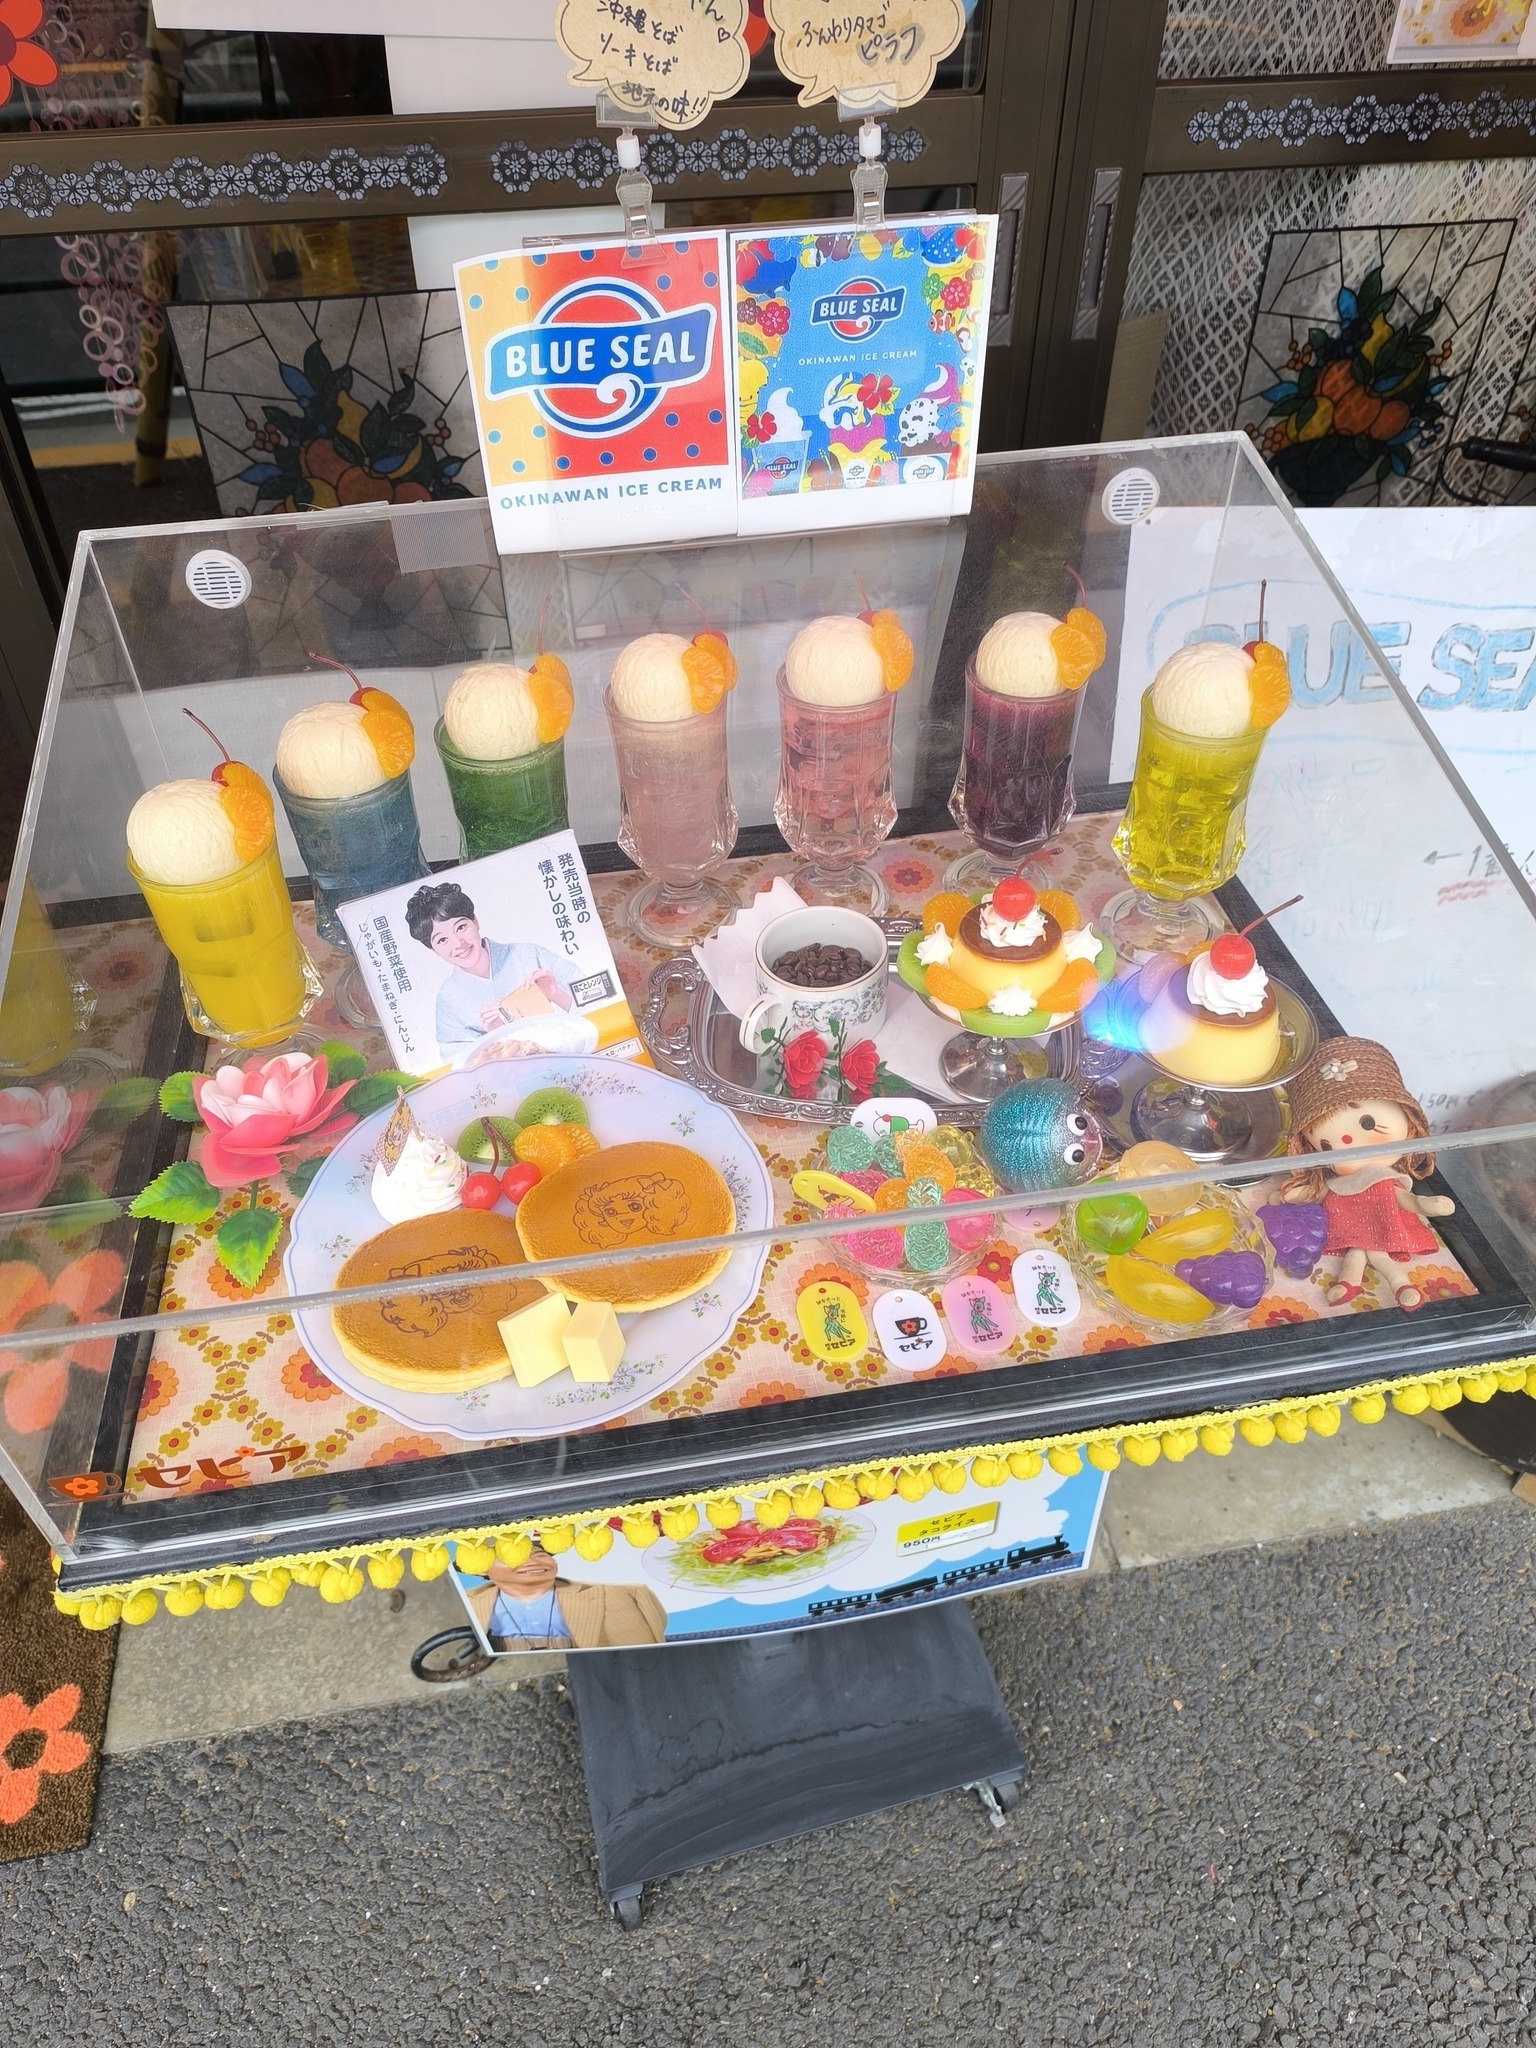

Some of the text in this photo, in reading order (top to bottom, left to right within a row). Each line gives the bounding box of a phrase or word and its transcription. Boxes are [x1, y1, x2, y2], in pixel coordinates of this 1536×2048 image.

[796, 5, 890, 48] ふんわりタマゴ
[861, 26, 917, 61] ピラフ
[600, 33, 679, 76] ソーキそば
[819, 296, 898, 318] BLUE SEAL
[505, 331, 696, 378] BLUE SEAL
[798, 350, 918, 366] OKINAWAN ICE CREAM
[500, 477, 723, 510] OKINAWAN ICE CREAM
[557, 852, 591, 924] 発売当時の
[537, 859, 580, 955] 懐かしの味わい
[373, 915, 413, 994] 国産野菜使用
[358, 922, 415, 1054] じゃがいも・たまねぎ・にんじん
[573, 976, 602, 994] 箱ごとレンジ
[899, 1339, 933, 1353] セピア
[133, 1445, 307, 1489] セピア
[919, 1517, 977, 1537] タコライス
[930, 1512, 967, 1526] セピア
[903, 1535, 941, 1549] 950円
